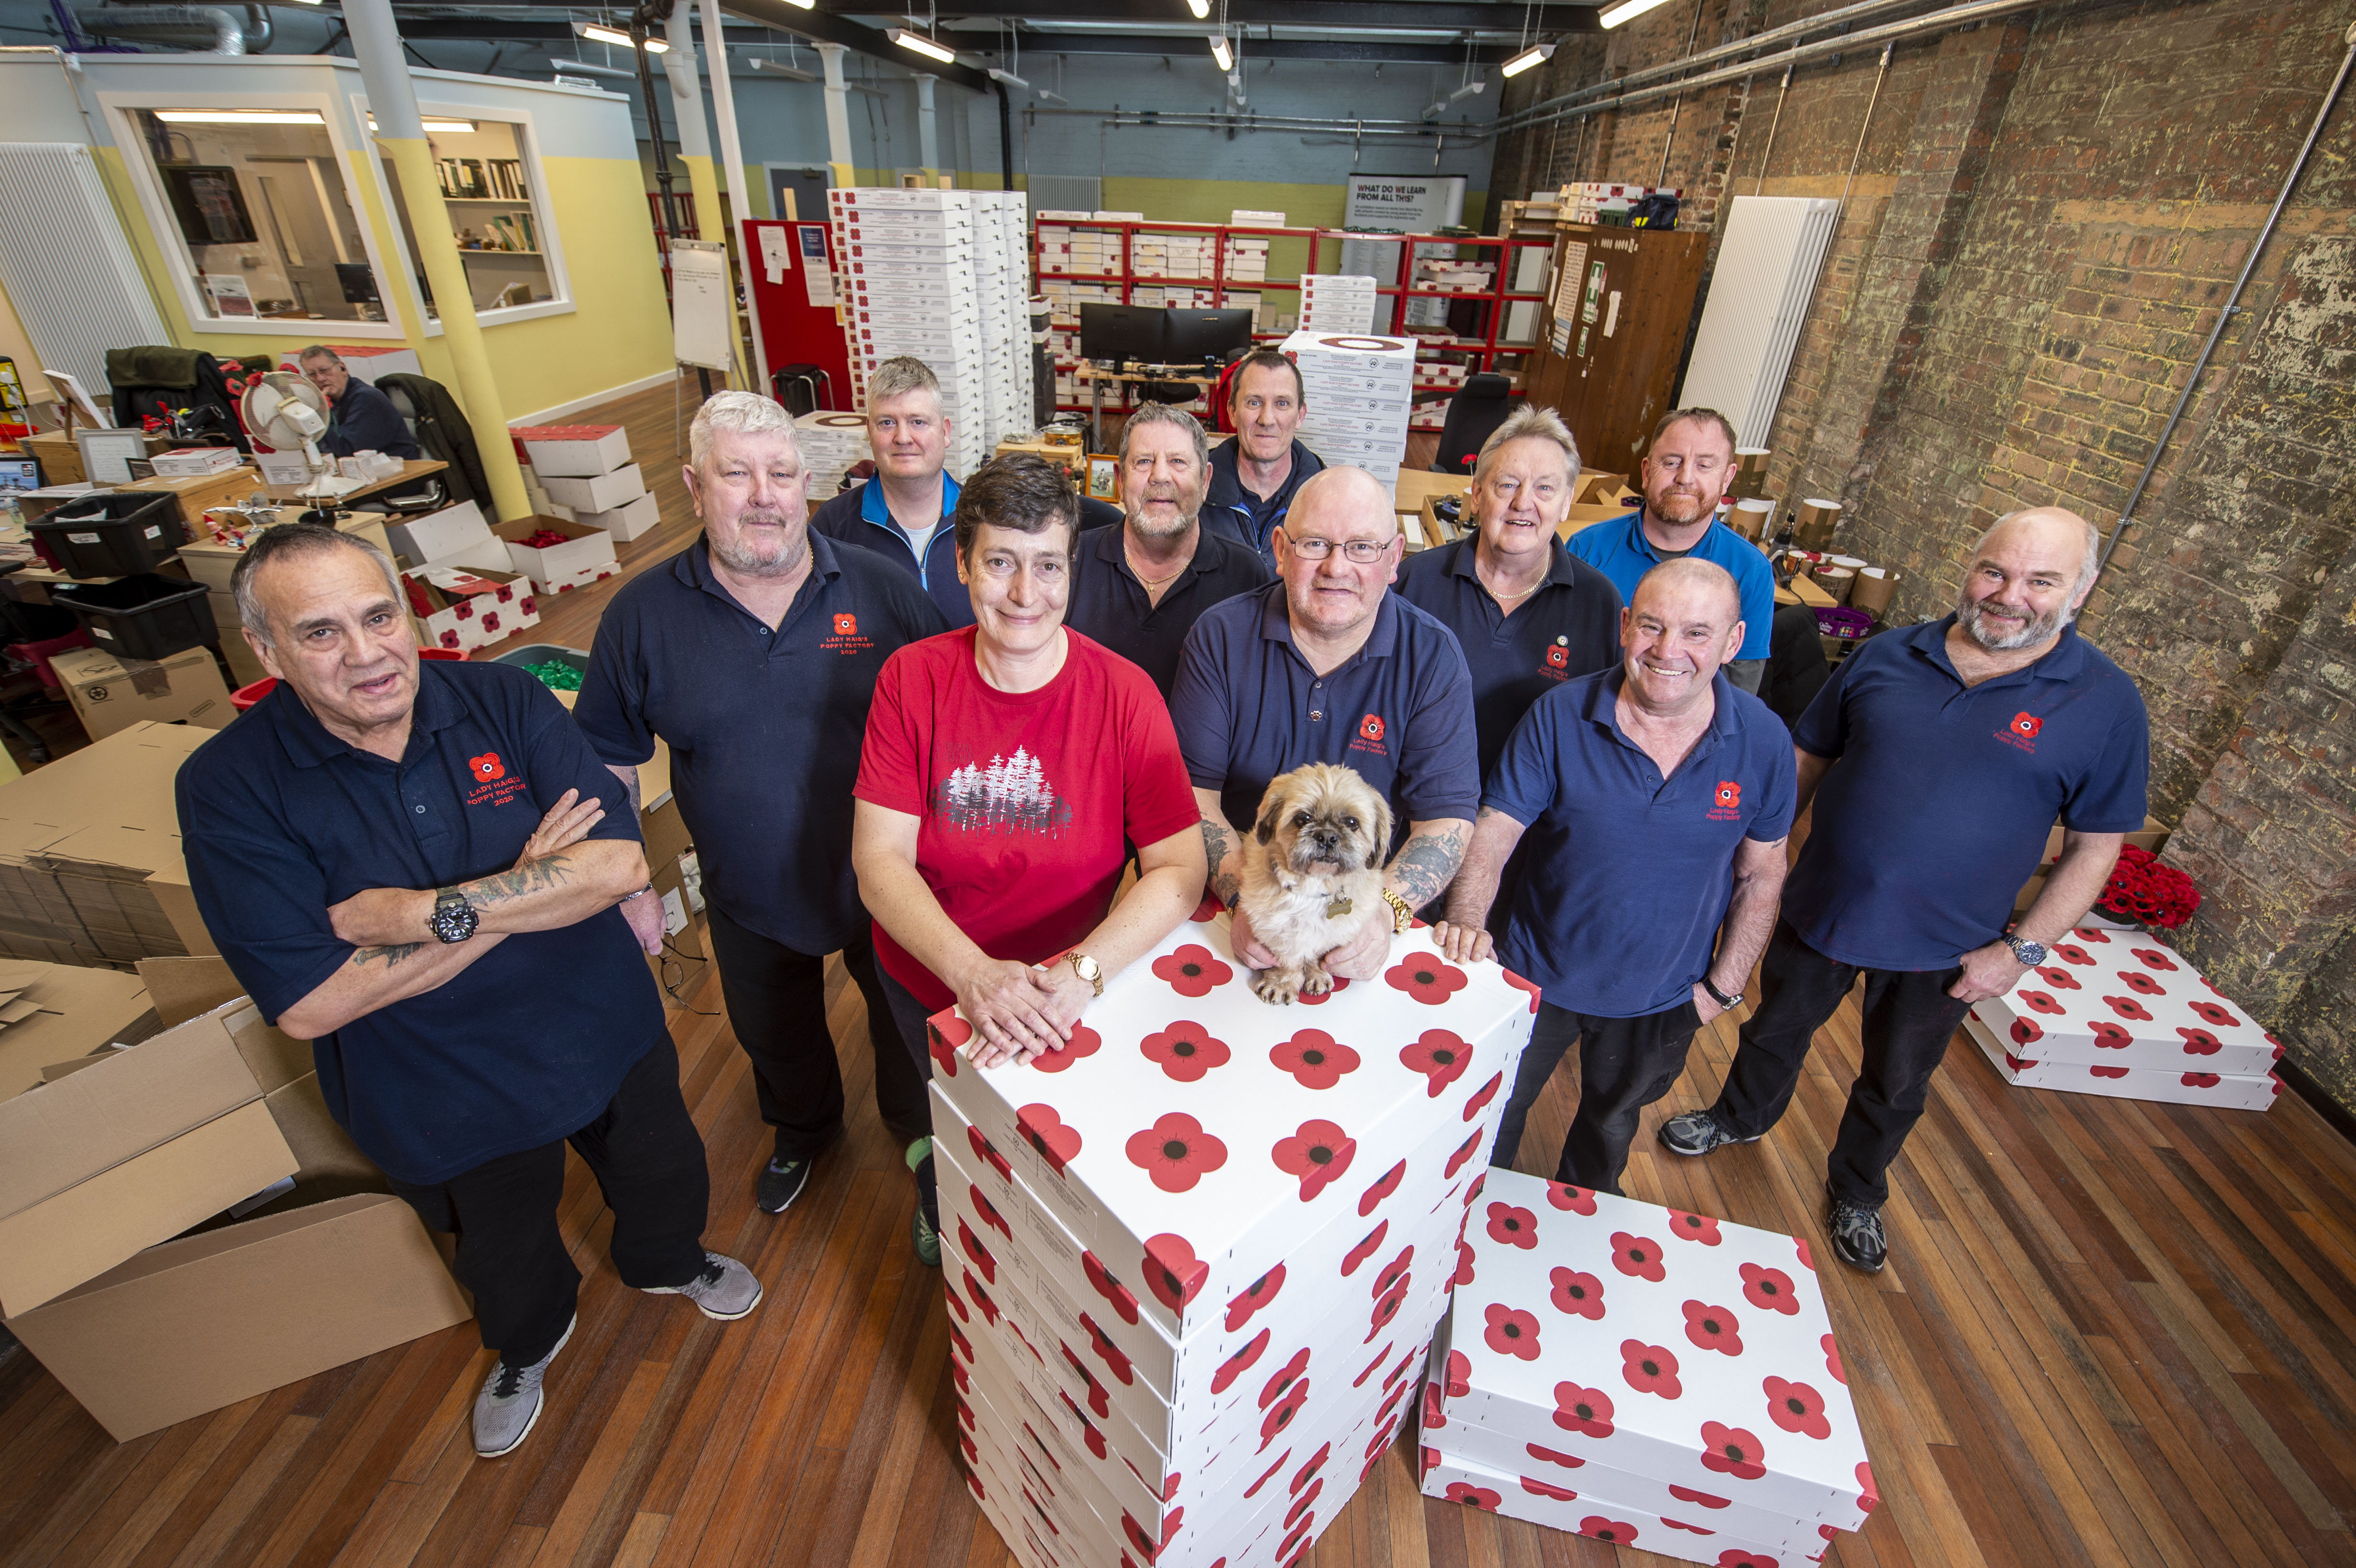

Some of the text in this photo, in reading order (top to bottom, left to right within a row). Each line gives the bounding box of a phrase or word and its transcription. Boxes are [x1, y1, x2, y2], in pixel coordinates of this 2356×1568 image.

[1356, 193, 1378, 201] FROM
[2000, 728, 2016, 739] Lady
[1368, 740, 1385, 749] Haig's
[1368, 747, 1387, 756] Factory
[469, 784, 492, 797] LADY
[494, 795, 514, 806] 2020
